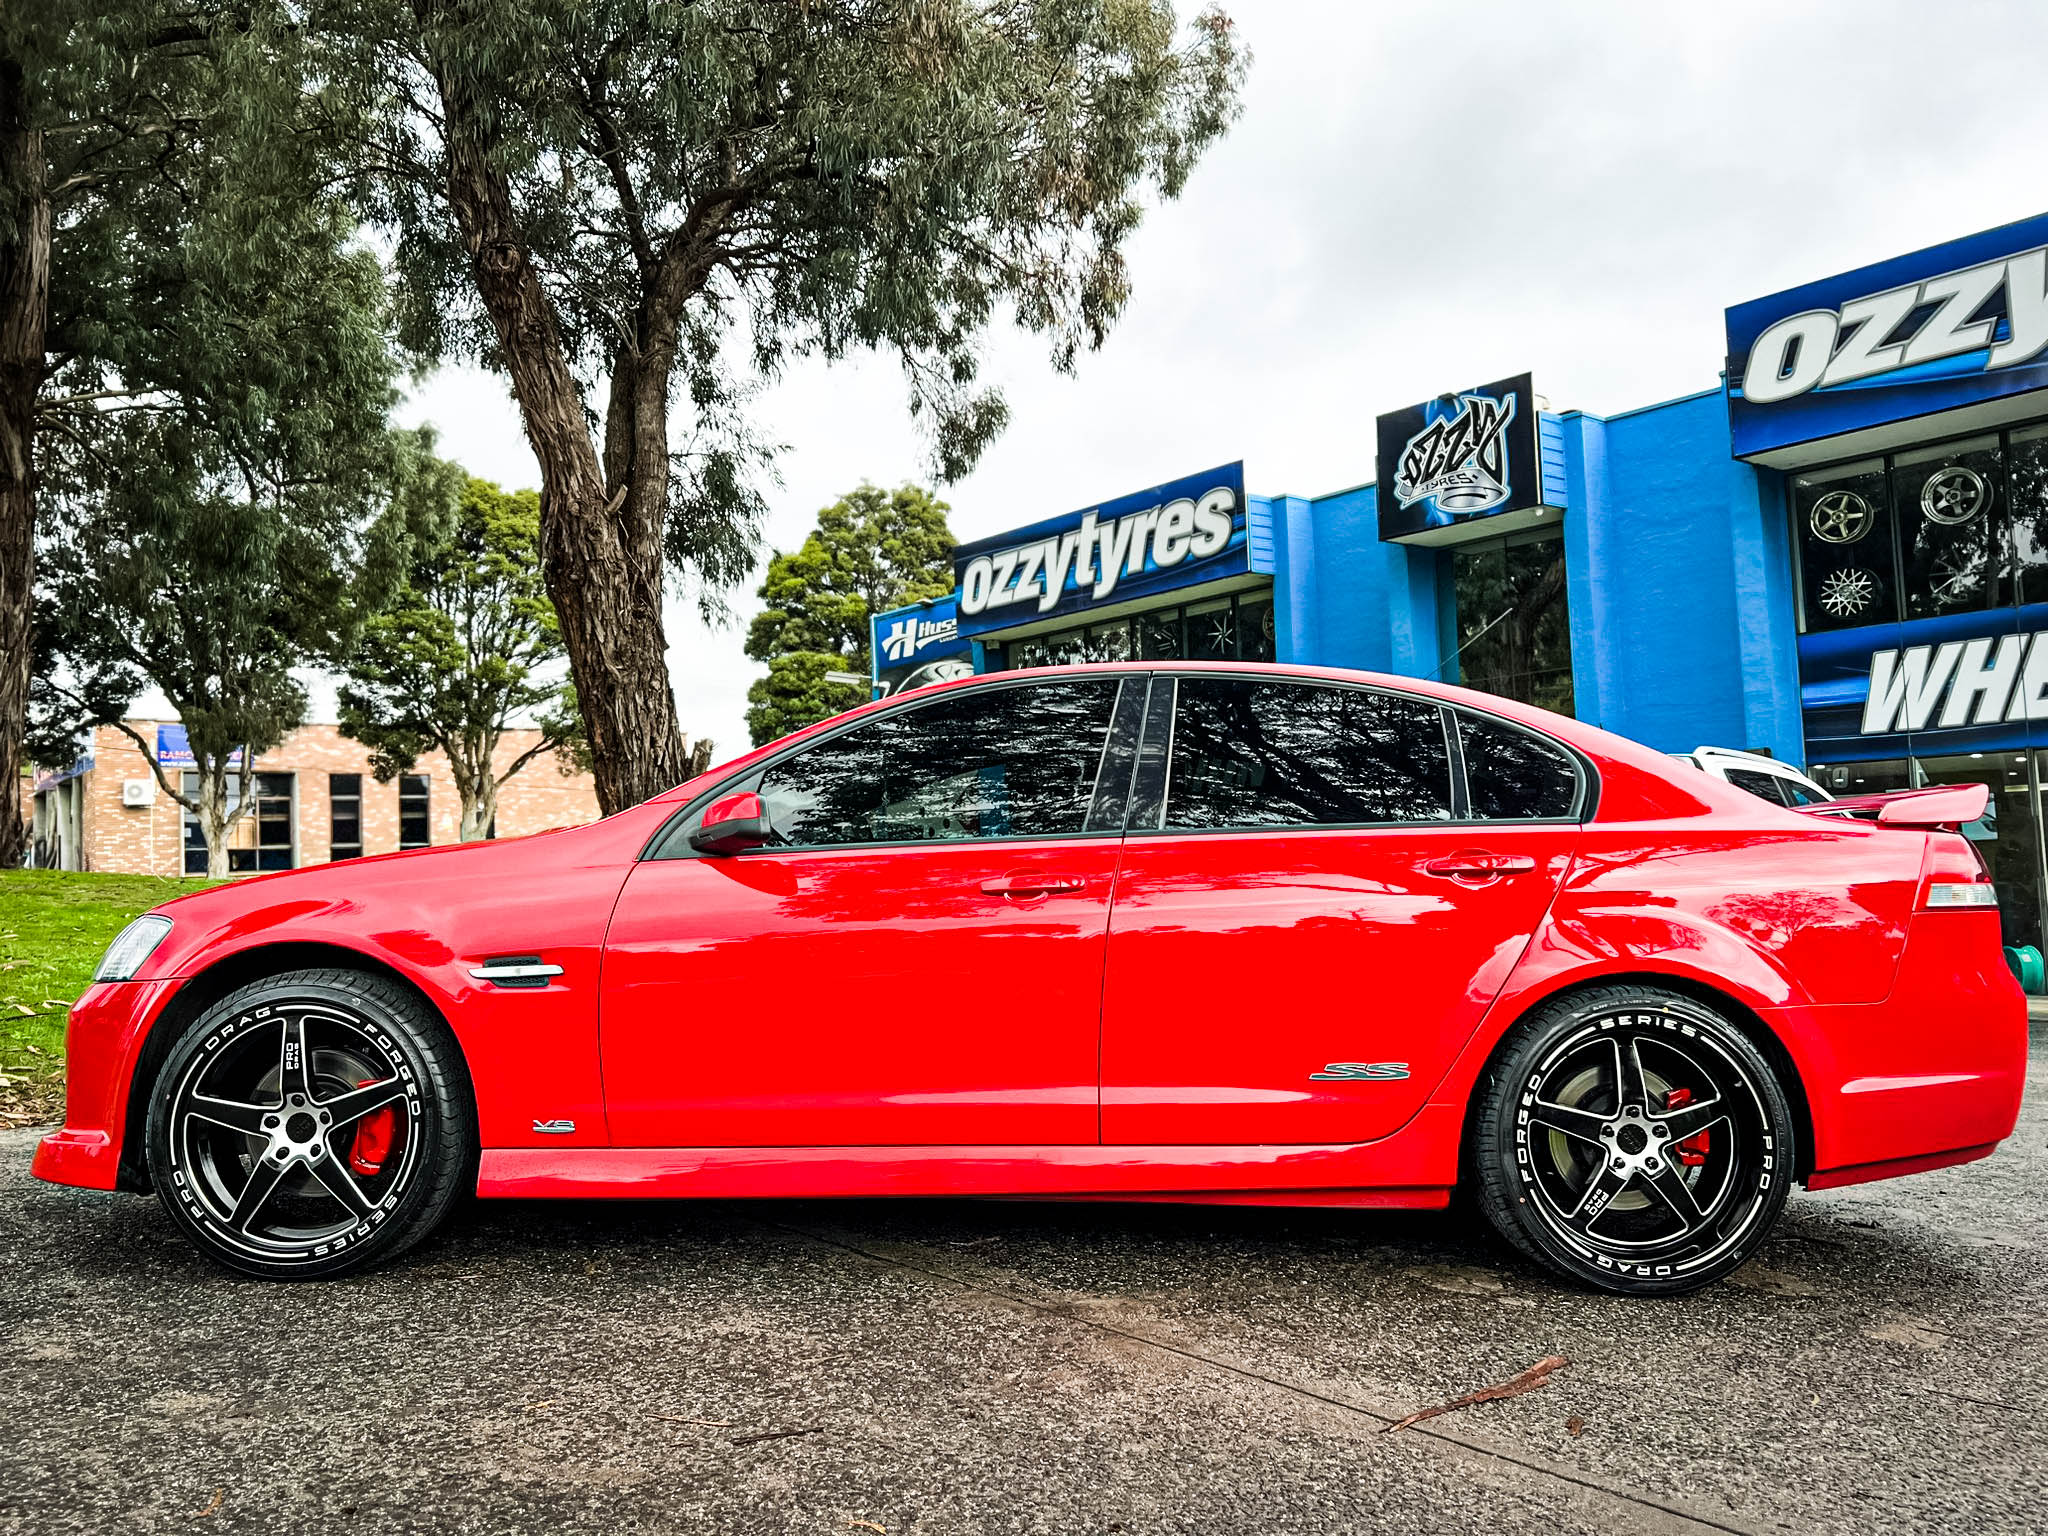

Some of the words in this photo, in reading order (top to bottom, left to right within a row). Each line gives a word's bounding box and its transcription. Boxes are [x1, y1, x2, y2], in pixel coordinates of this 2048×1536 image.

[1423, 472, 1476, 491] TYRES
[961, 486, 1236, 615] ozzytyres
[205, 1007, 270, 1051] DRAG
[1600, 1015, 1697, 1038] SERIES
[286, 1043, 294, 1070] PRO
[364, 1023, 421, 1116] FORGED
[1309, 1062, 1411, 1081] SS
[1517, 1075, 1542, 1182] FORGED
[1759, 1135, 1774, 1189] PRO
[173, 1170, 205, 1219] PRO
[1588, 1191, 1609, 1216] PRO
[314, 1194, 398, 1256] SERIES
[1597, 1254, 1671, 1276] DRAG
